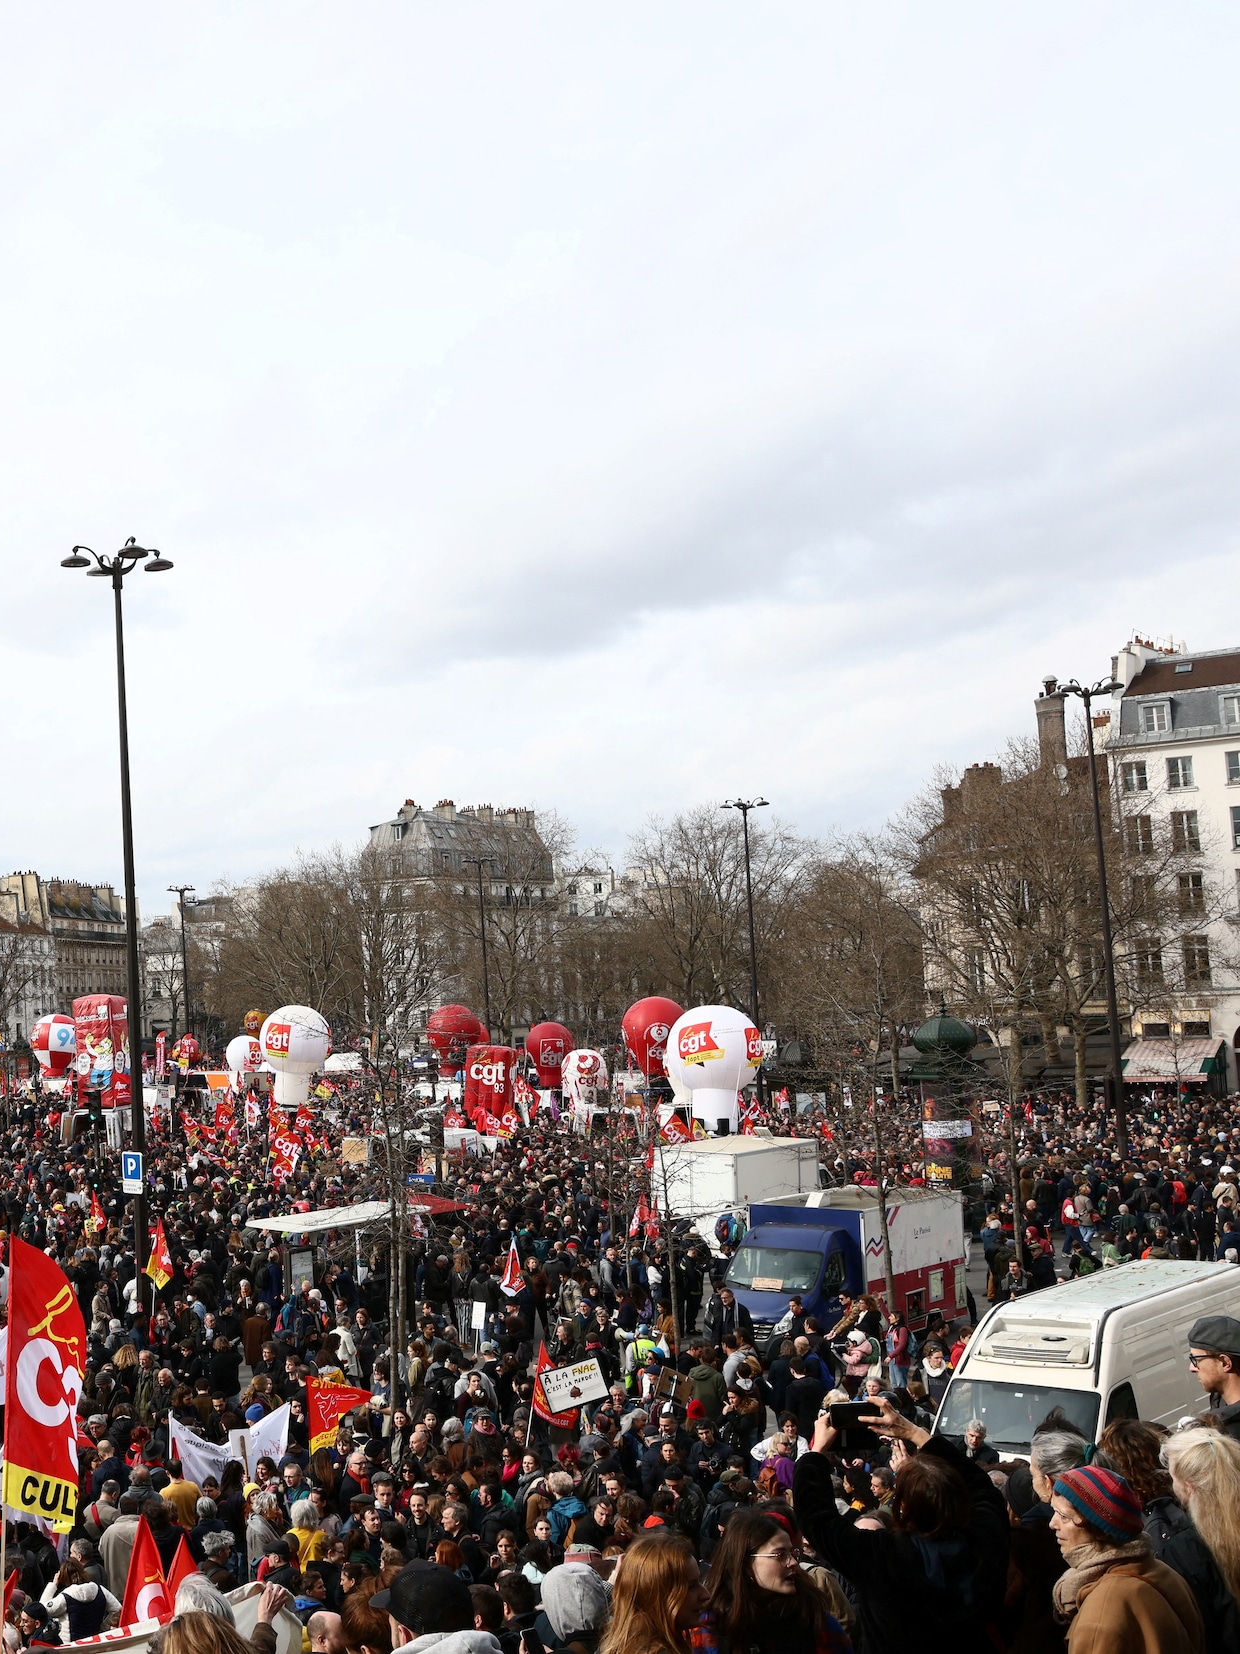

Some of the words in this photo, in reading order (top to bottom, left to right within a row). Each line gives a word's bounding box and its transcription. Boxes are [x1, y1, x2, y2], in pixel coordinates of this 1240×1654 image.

[266, 1032, 289, 1049] cgt
[680, 1030, 707, 1053] cgt
[470, 1061, 505, 1086] cgt
[579, 1074, 599, 1088] cgt
[493, 1083, 505, 1094] 93
[275, 1138, 299, 1157] cgt
[127, 1158, 136, 1175] P
[544, 1374, 551, 1386] À
[556, 1371, 568, 1382] LA
[572, 1363, 597, 1377] FNAC
[546, 1385, 562, 1394] C'EST
[21, 1475, 79, 1517] CUL
